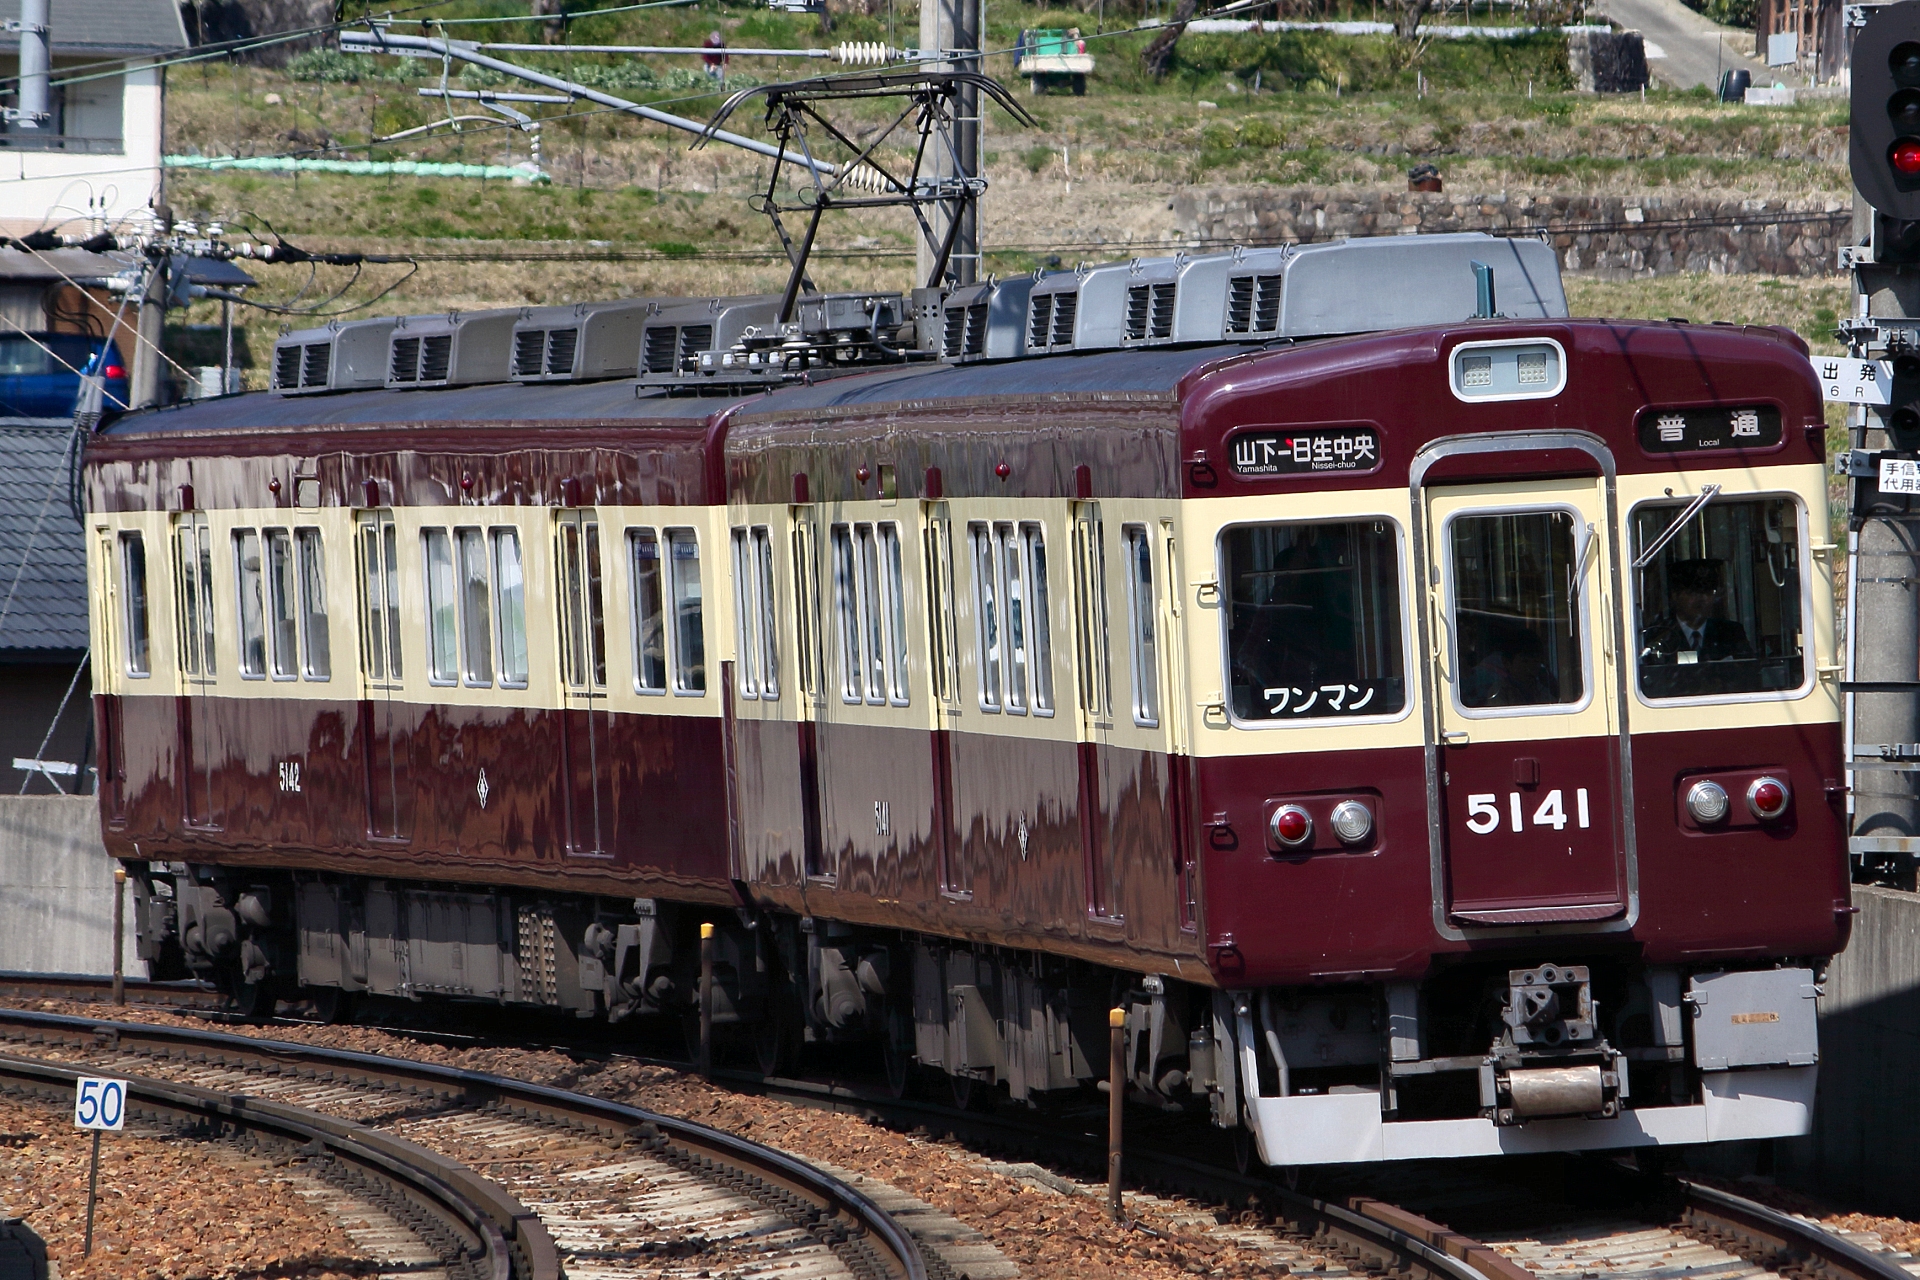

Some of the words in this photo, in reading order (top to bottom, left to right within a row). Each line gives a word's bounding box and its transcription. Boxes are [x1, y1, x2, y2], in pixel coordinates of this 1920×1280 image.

[1823, 362, 1877, 382] 出発
[1656, 409, 1761, 442] 普通
[1698, 438, 1720, 447] Local
[1236, 463, 1278, 473] Yamashita
[1311, 460, 1356, 470] Nissei-chuo
[1885, 462, 1920, 476] 手信
[1263, 684, 1374, 715] ワンマン
[279, 762, 301, 792] 5142
[1465, 788, 1590, 835] 5141
[78, 1081, 122, 1127] 50
